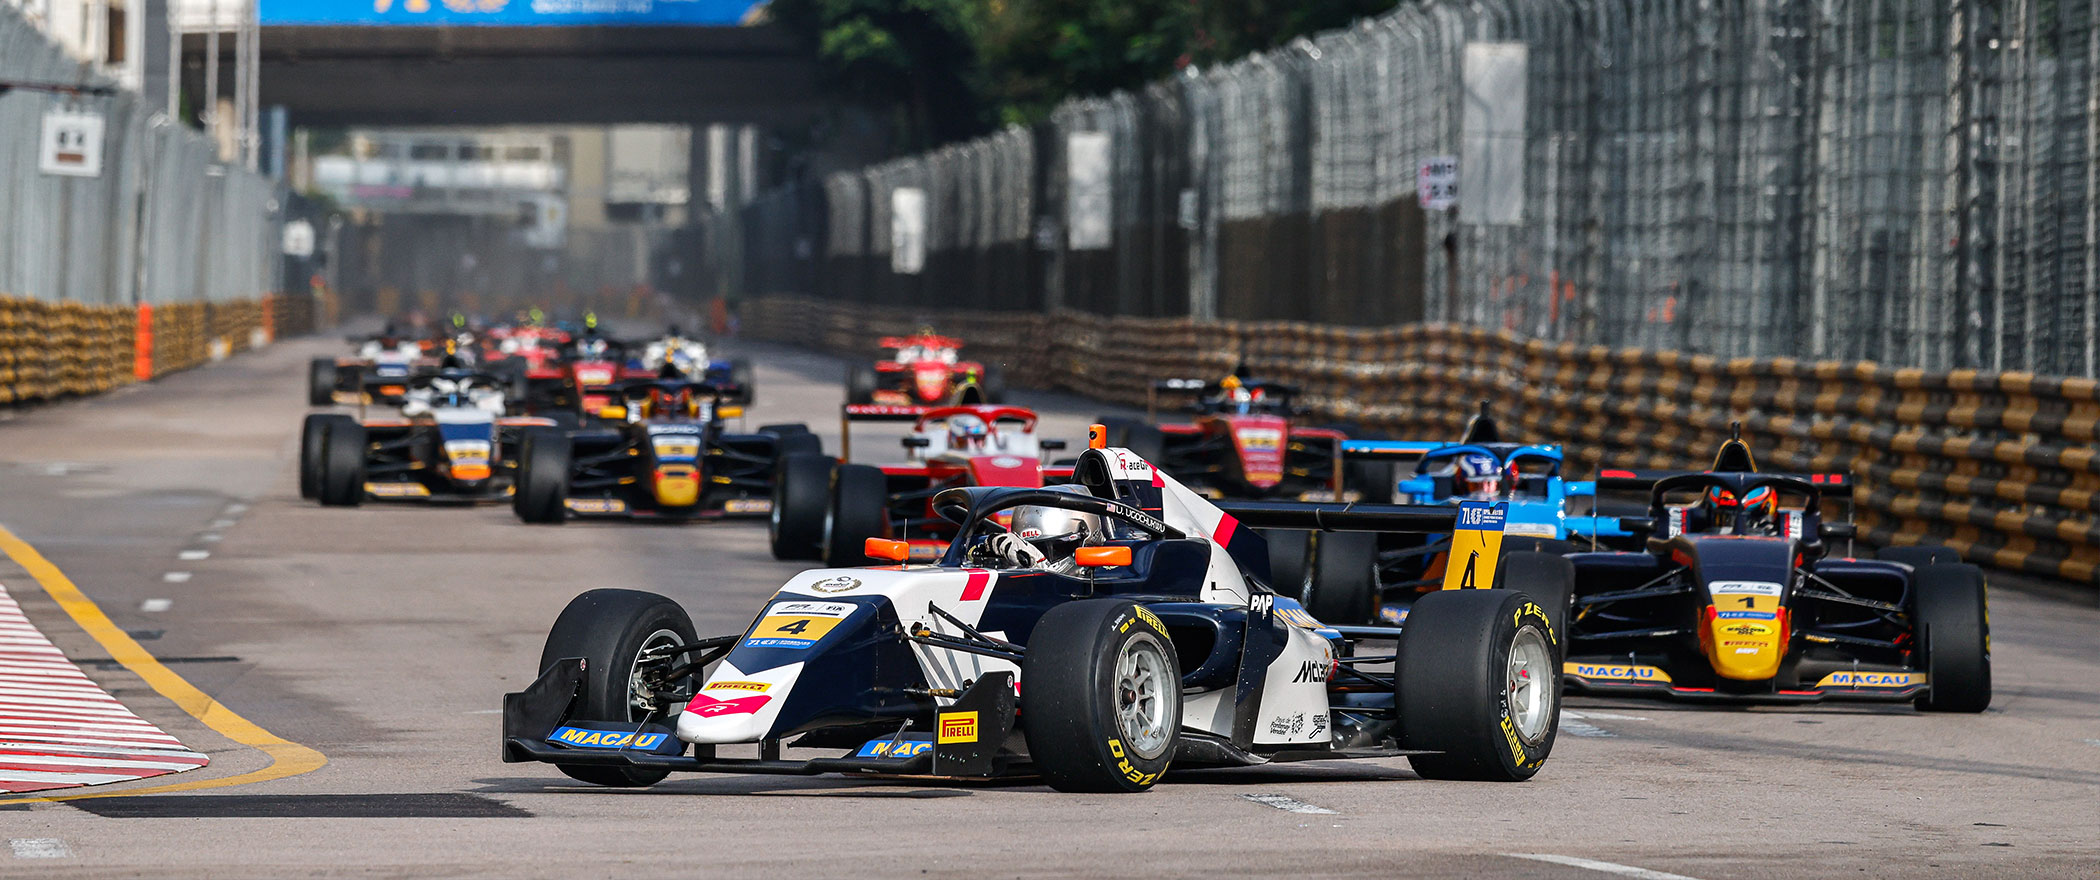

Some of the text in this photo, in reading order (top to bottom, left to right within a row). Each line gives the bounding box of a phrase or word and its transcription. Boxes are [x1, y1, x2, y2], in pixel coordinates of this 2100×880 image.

[1022, 529, 1039, 537] BELL
[1738, 597, 1754, 608] 1
[776, 619, 811, 634] 4
[1514, 602, 1556, 645] P ZERO
[1578, 666, 1654, 678] MACAU
[1833, 674, 1909, 685] MACAU
[710, 682, 765, 691] PIRELLI
[942, 718, 974, 737] PIRELLI
[560, 729, 657, 747] MACAU
[870, 742, 932, 755] MAC
[1108, 739, 1156, 785] ZERO
